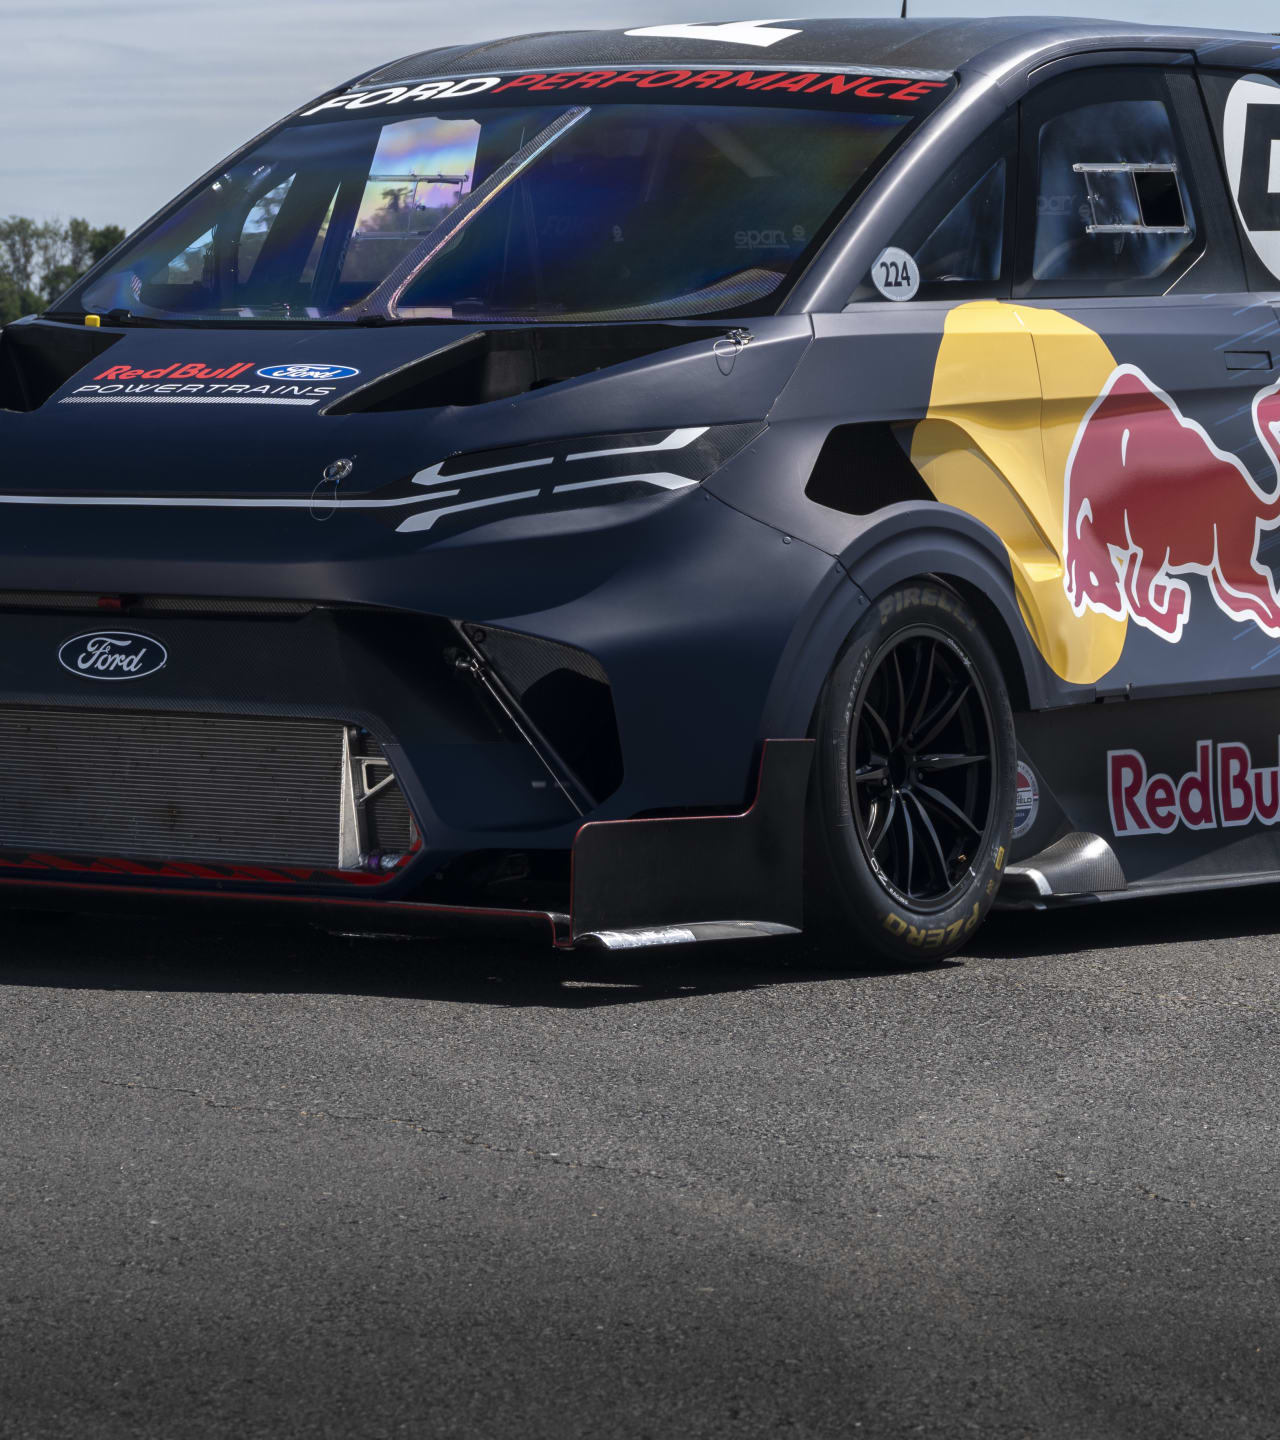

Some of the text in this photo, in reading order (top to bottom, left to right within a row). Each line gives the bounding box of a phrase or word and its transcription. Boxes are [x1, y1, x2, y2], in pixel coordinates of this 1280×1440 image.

[299, 70, 948, 117] FORD PERFORMANCE
[880, 260, 911, 287] 224
[271, 364, 343, 379] Ford
[71, 383, 337, 397] POWERTRAINS
[77, 636, 148, 672] Ford
